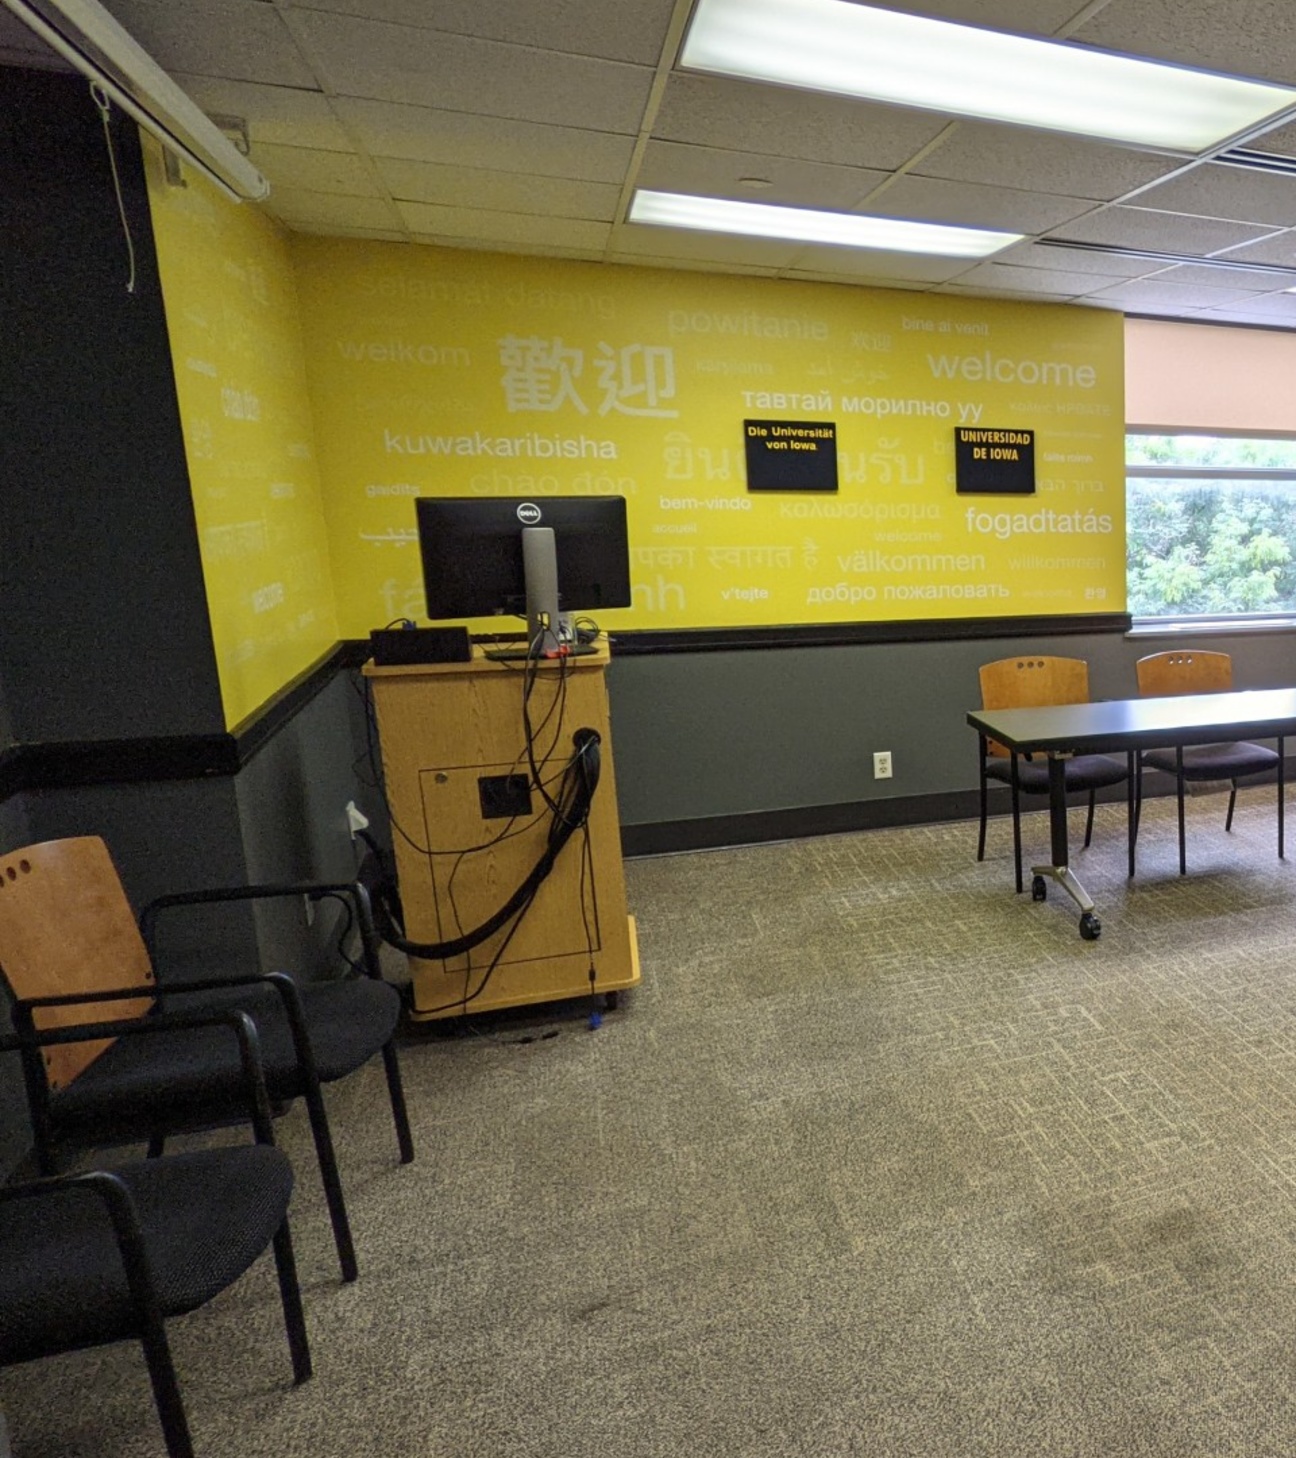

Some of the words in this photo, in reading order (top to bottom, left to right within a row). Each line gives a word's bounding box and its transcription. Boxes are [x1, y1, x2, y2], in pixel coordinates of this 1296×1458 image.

[667, 309, 829, 341] powitanie
[337, 340, 471, 366] welkom
[927, 350, 1097, 388] welcome
[741, 389, 833, 412] тавтай
[841, 396, 950, 420] морилно
[958, 402, 984, 424] уу
[748, 426, 768, 437] Die
[772, 426, 834, 438] Universität
[961, 430, 1030, 446] UNIVERSIDAD
[384, 428, 618, 460] kuwakaribisha
[766, 441, 788, 450] von
[791, 440, 817, 451] Iowa
[974, 447, 987, 460] DE
[990, 448, 1018, 461] IOWA
[659, 495, 752, 510] bem-vindo
[652, 523, 698, 534] accueil
[965, 506, 1112, 539] fogadtatás
[873, 529, 943, 543] welcome
[837, 551, 986, 572] välkommen
[1008, 553, 1106, 571] willkommen
[806, 581, 877, 605] добро
[883, 584, 1010, 600] пожаловать
